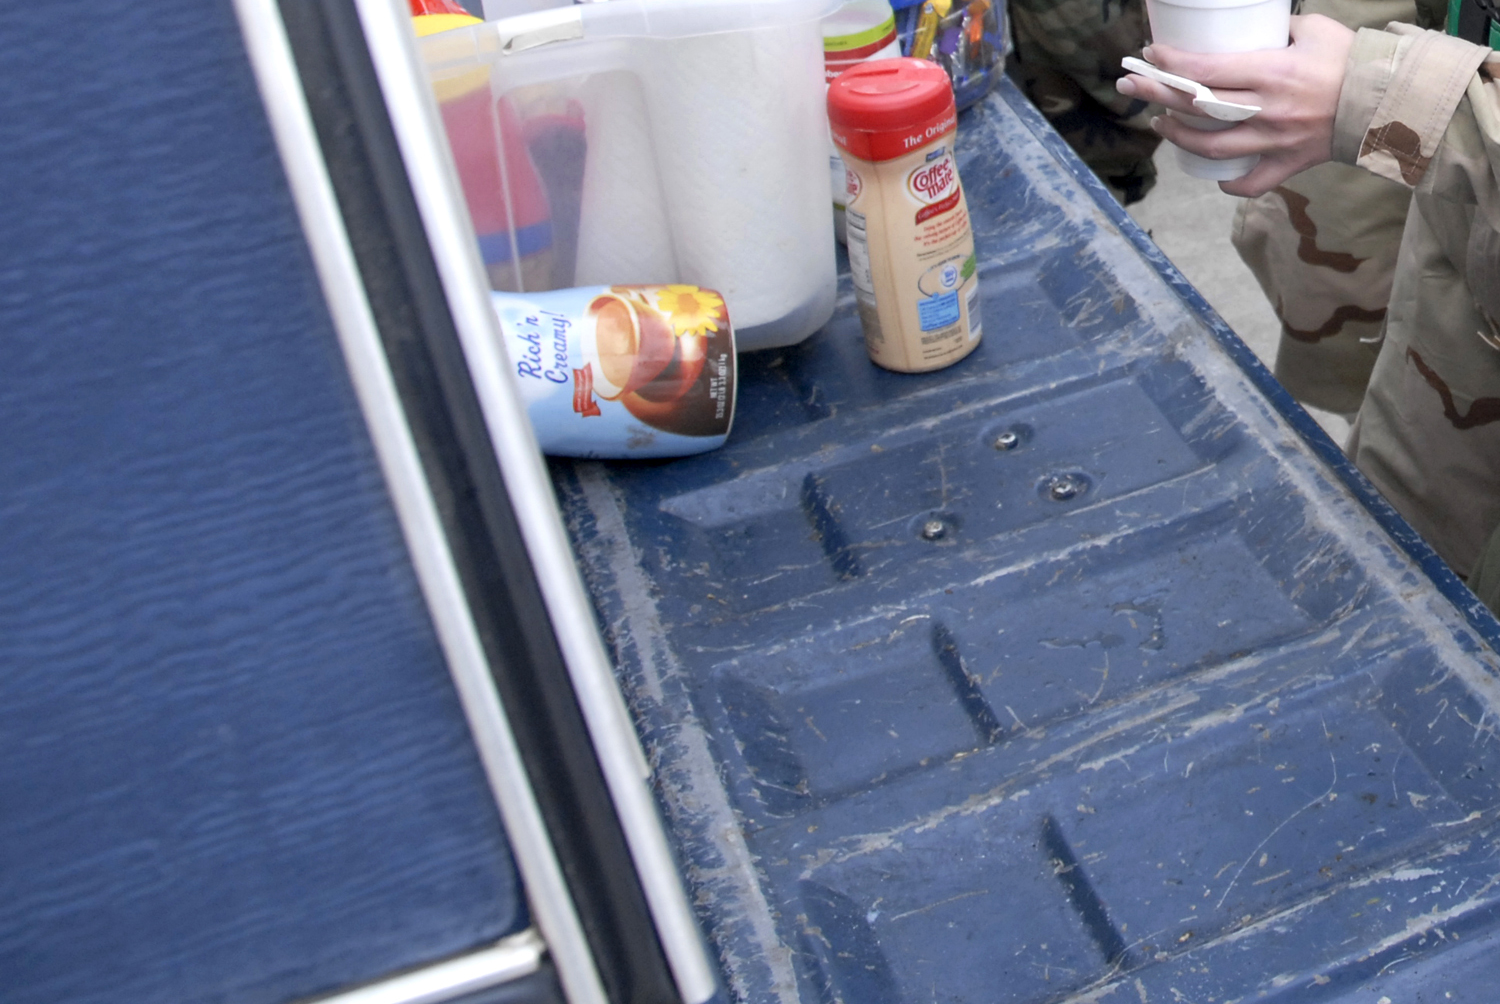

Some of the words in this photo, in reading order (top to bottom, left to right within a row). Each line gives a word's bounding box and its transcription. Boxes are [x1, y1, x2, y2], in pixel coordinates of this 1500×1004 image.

[902, 134, 923, 149] The
[517, 333, 543, 381] Rich
[540, 310, 572, 384] Creamy!
